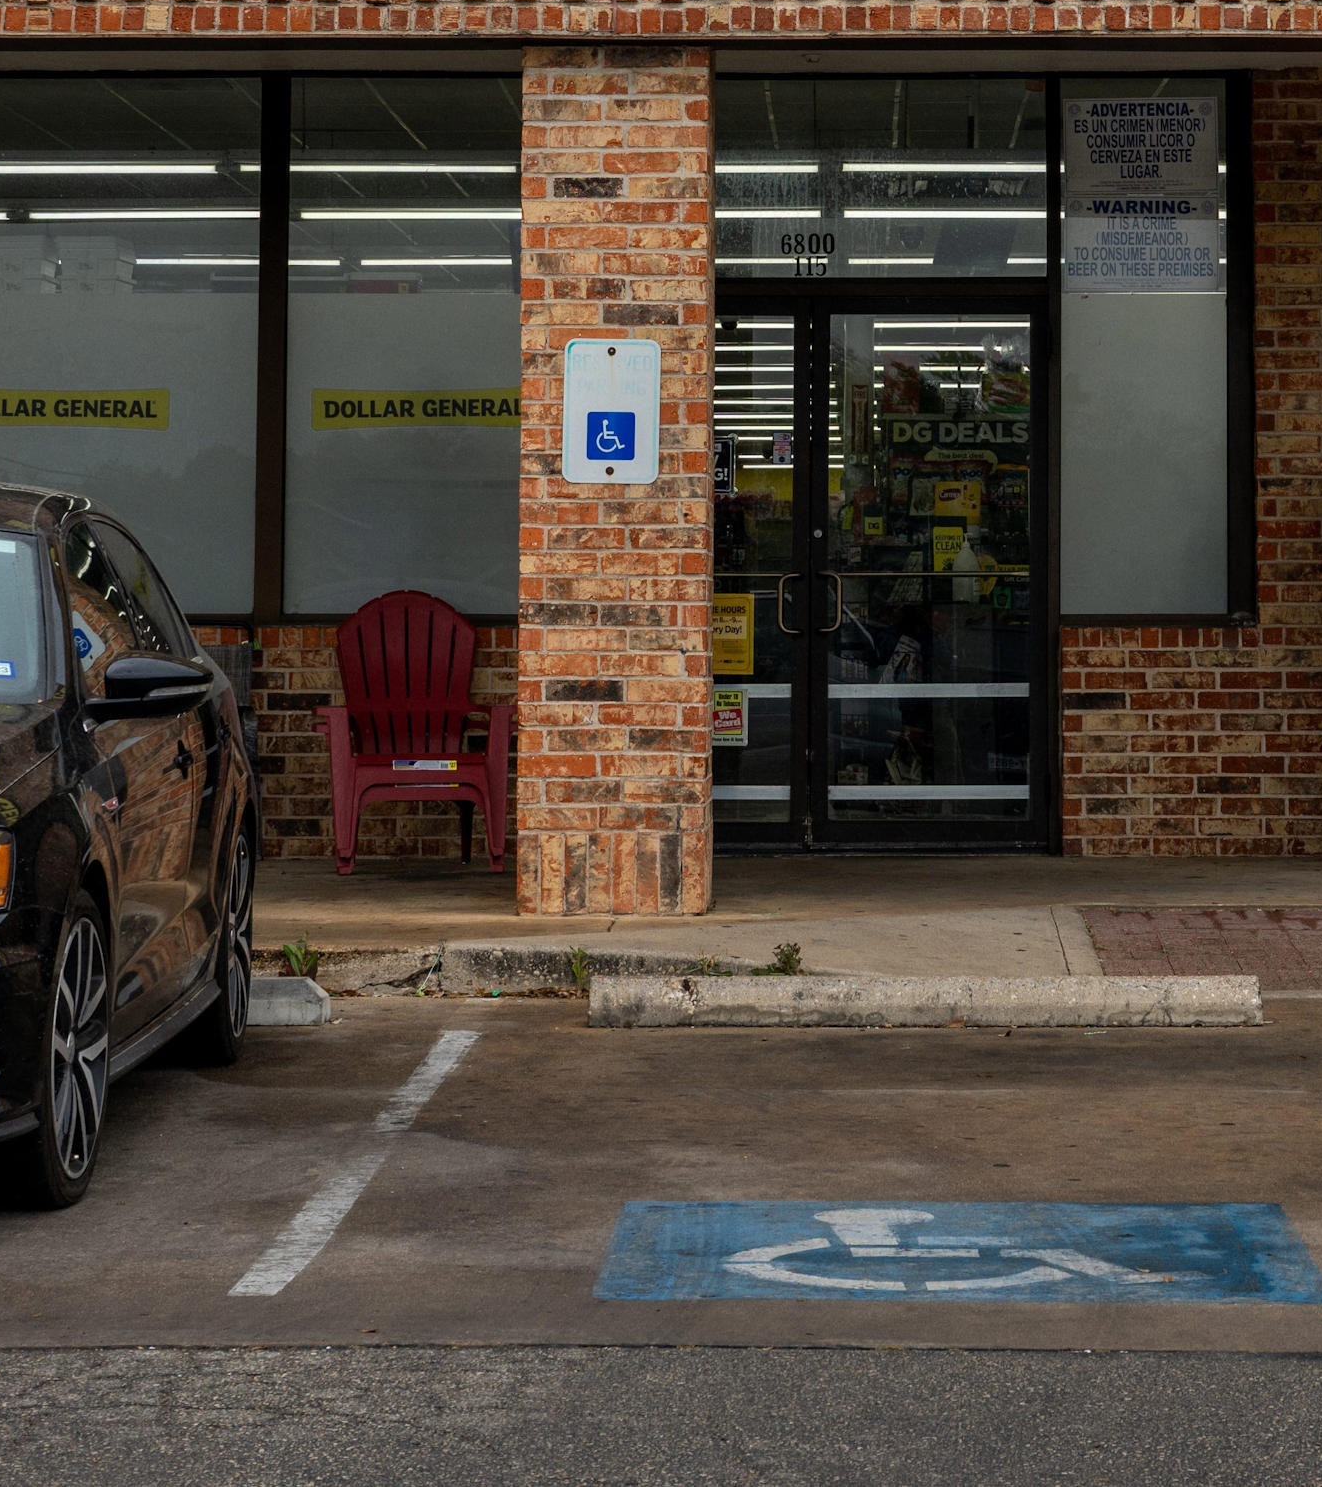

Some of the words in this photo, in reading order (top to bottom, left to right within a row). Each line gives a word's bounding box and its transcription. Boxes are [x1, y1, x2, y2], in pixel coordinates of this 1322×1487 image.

[1074, 120, 1089, 133] ES
[1092, 119, 1108, 133] UN
[1111, 119, 1155, 132] CRIMEN
[1156, 118, 1206, 132] (MENOR)
[1086, 134, 1146, 148] CONSUMIR
[1150, 134, 1185, 147] LICOR
[1187, 133, 1195, 147] O
[1090, 149, 1142, 163] CERVEZA
[1145, 149, 1160, 163] EN
[1164, 148, 1192, 162] ESTE
[1120, 164, 1162, 178] LUGAR.
[1108, 216, 1117, 229] IT
[1120, 216, 1129, 229] IS
[1132, 216, 1141, 229] A
[1143, 216, 1177, 229] CRIME
[781, 233, 835, 254] 6800
[1095, 232, 1188, 246] (MISDEMEANOR)
[1074, 247, 1089, 261] TO
[1091, 247, 1147, 261] CONSUME
[1150, 247, 1191, 262] LIQUOR
[1194, 247, 1210, 261] OR
[794, 256, 827, 276] 115
[1068, 263, 1098, 277] BEER
[1101, 263, 1117, 276] ON
[1121, 263, 1153, 276] THESE
[54, 398, 158, 418] GENERAL
[324, 399, 414, 418] DOLLAR
[893, 421, 932, 443] DG
[939, 421, 1030, 443] DEALS
[721, 606, 746, 614] HOURS
[718, 711, 736, 719] We
[715, 718, 741, 728] Card
